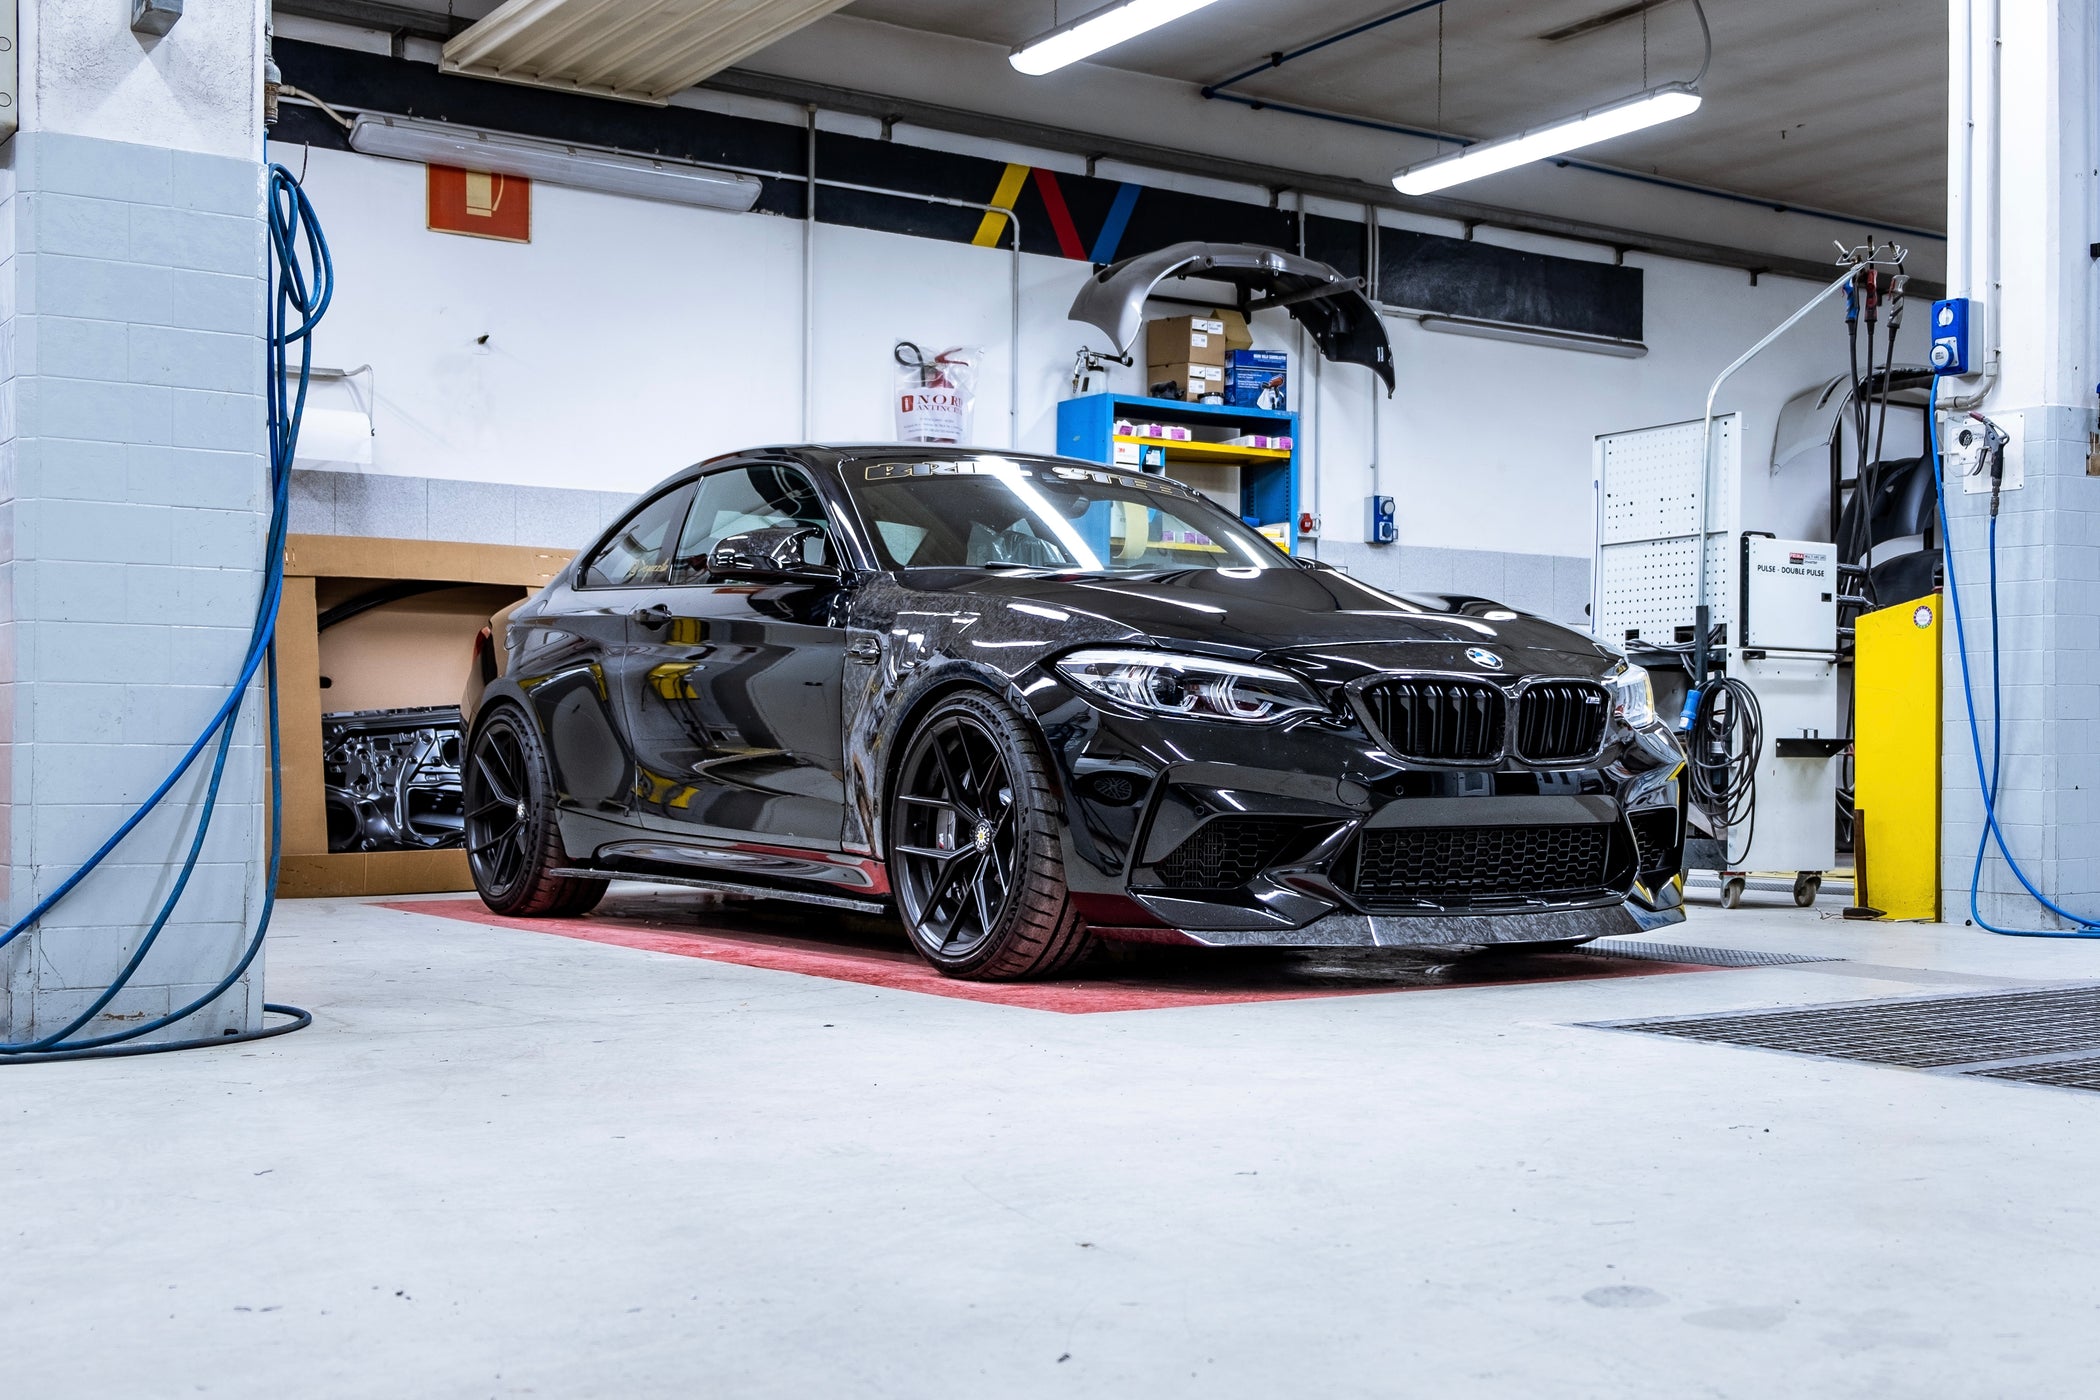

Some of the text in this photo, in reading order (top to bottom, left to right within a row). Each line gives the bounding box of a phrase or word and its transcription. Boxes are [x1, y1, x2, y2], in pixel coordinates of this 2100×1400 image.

[1757, 564, 1776, 573] PULSE
[1781, 566, 1805, 576] DOUBLE
[1806, 568, 1825, 577] PULSE
